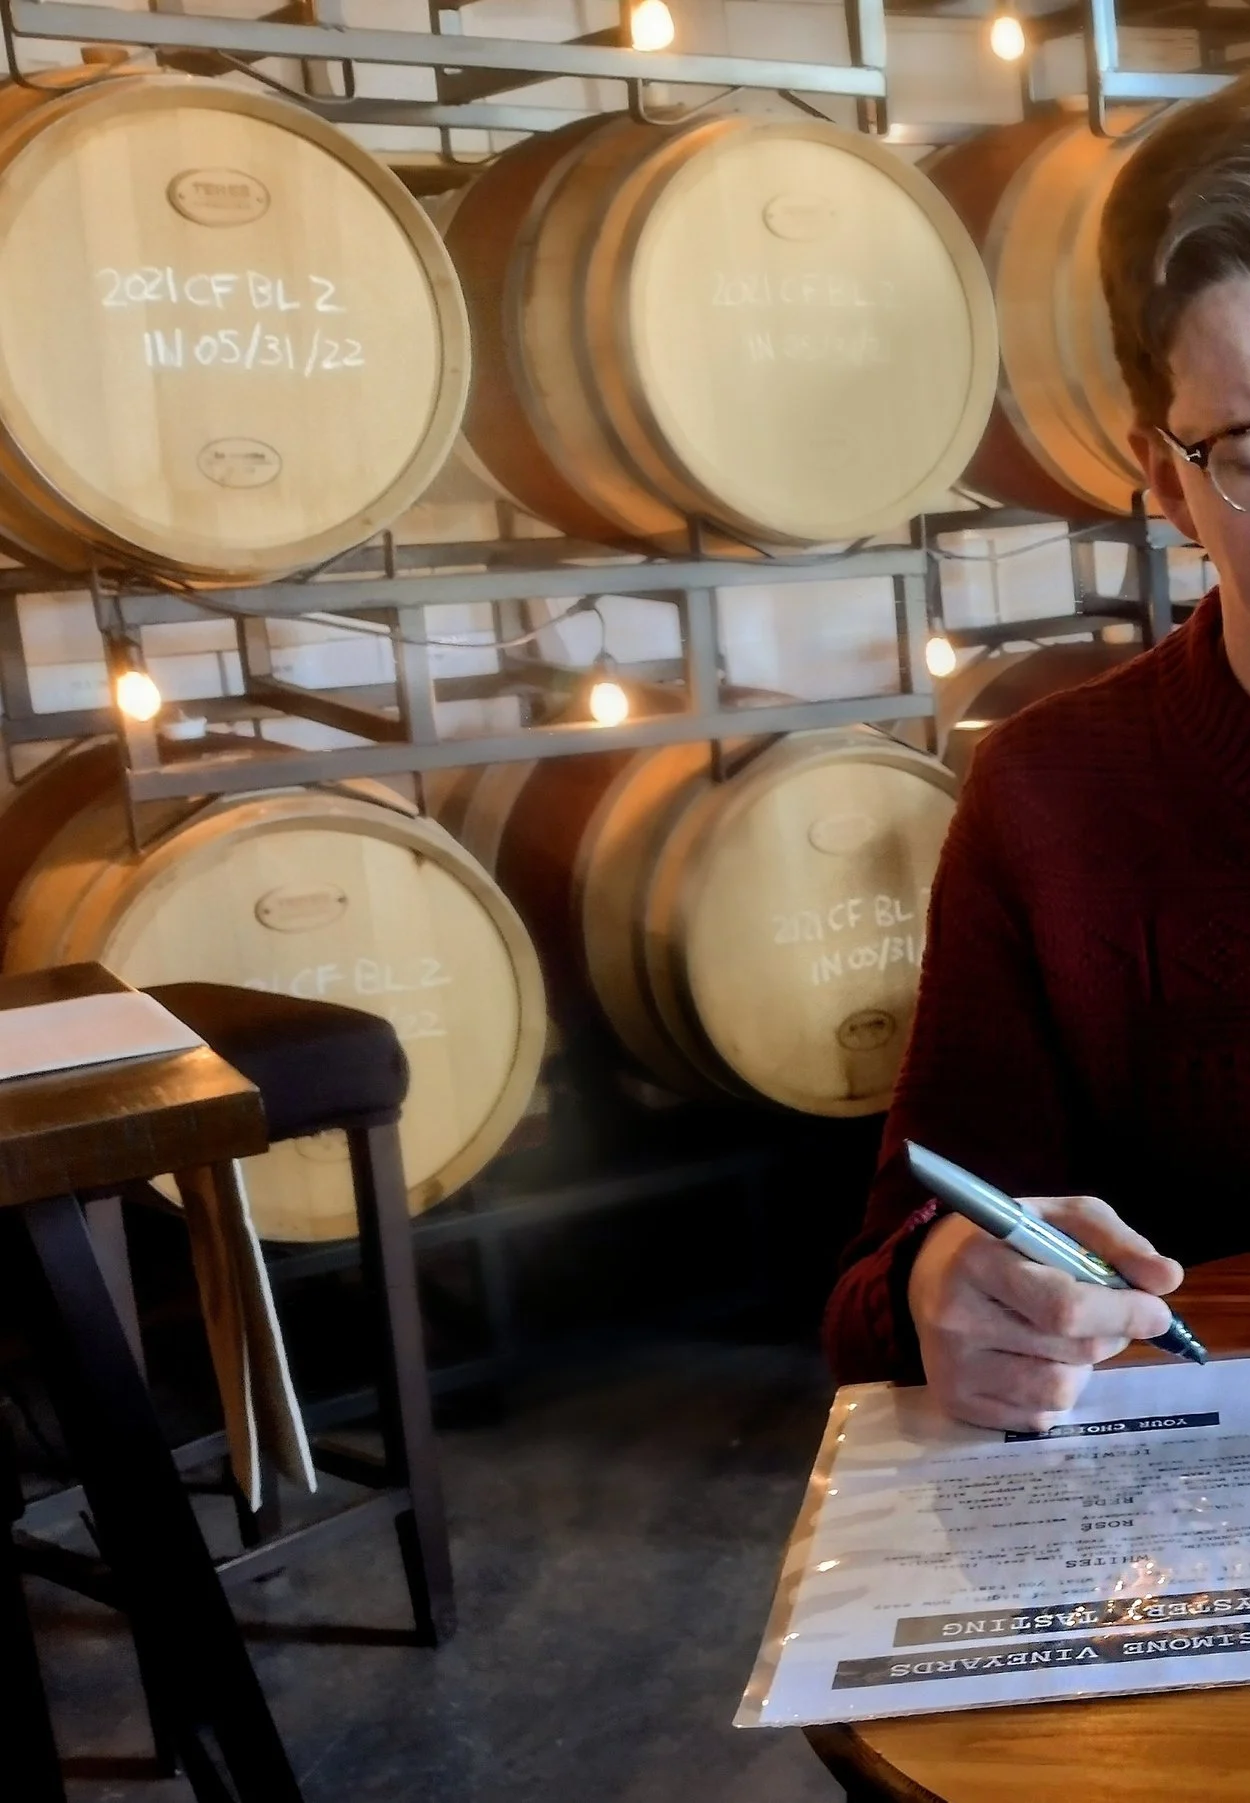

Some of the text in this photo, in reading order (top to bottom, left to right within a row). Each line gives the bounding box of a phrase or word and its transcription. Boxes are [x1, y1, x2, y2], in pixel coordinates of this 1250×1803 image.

[144, 327, 183, 368] IN
[1139, 1417, 1187, 1430] YOUR
[1081, 1519, 1134, 1533] ROSÉ
[1066, 1553, 1150, 1570] WHITES
[942, 1609, 1098, 1636] TASTING
[889, 1646, 1099, 1677] VINEYARDS
